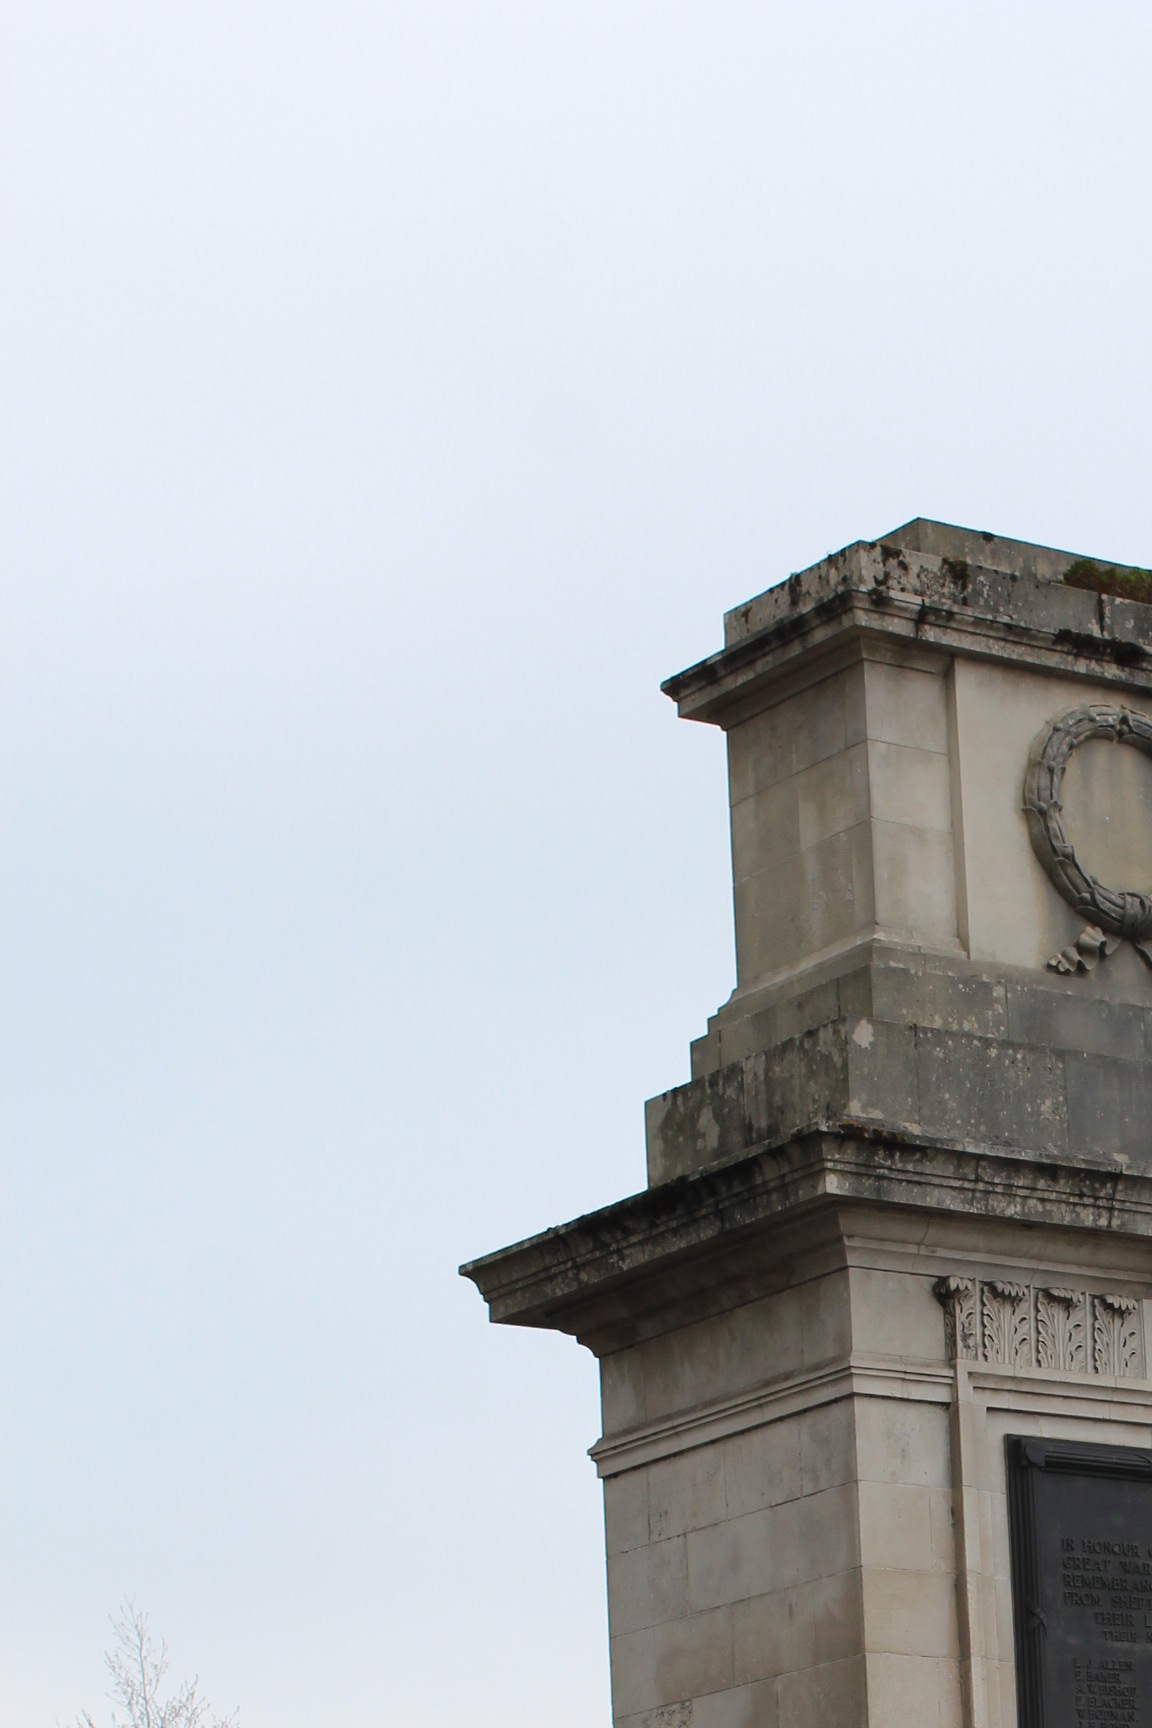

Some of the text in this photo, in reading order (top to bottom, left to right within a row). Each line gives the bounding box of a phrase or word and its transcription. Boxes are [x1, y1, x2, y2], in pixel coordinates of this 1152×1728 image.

[1061, 1536, 1074, 1551] IN
[1082, 1538, 1139, 1557] HONOUR
[1062, 1554, 1110, 1572] GREAT
[1119, 1559, 1151, 1575] WAR
[1063, 1589, 1101, 1607] FROM
[1094, 1609, 1134, 1626] THEIR
[1103, 1628, 1136, 1642] THEIR
